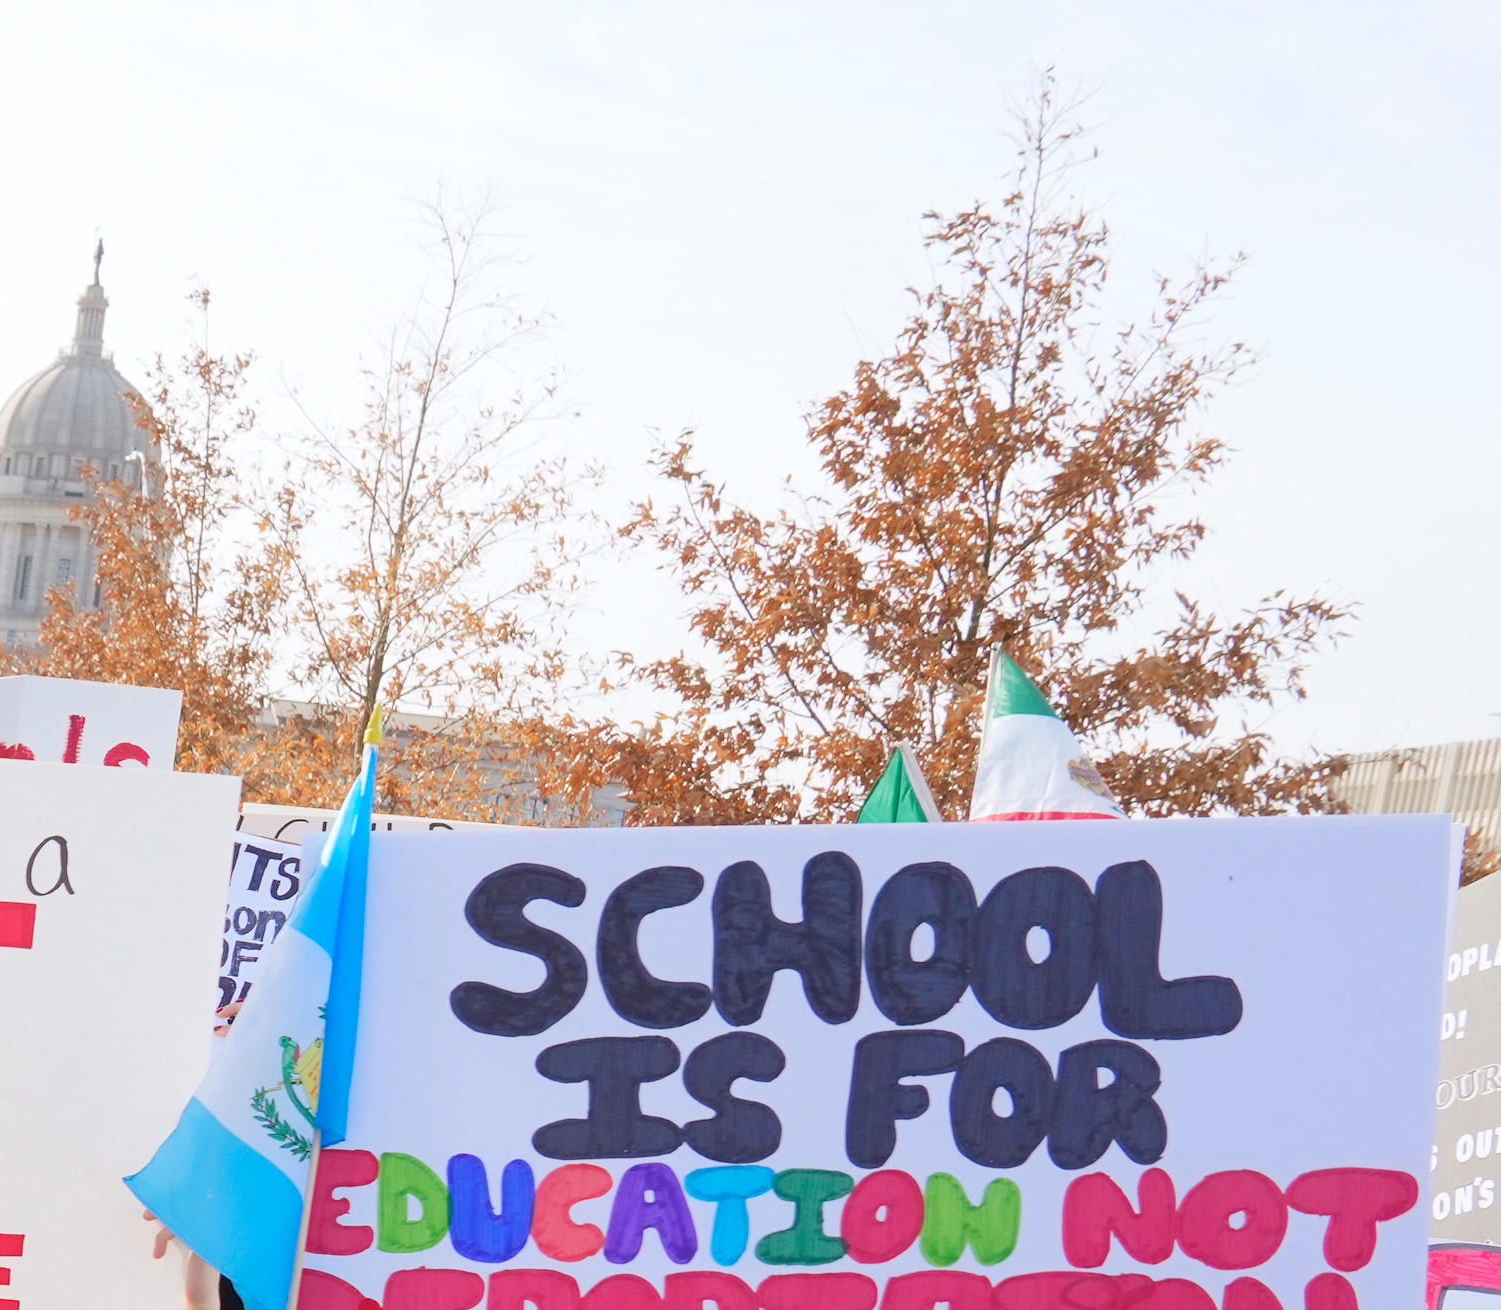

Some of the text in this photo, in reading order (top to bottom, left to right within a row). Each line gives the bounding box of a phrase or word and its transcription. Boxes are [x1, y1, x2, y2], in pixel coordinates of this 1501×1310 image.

[26, 834, 76, 896] a
[449, 848, 1244, 1040] SCHOOL
[532, 1028, 1167, 1171] IS FOR
[304, 1148, 1419, 1272] EDUCATION NOT
